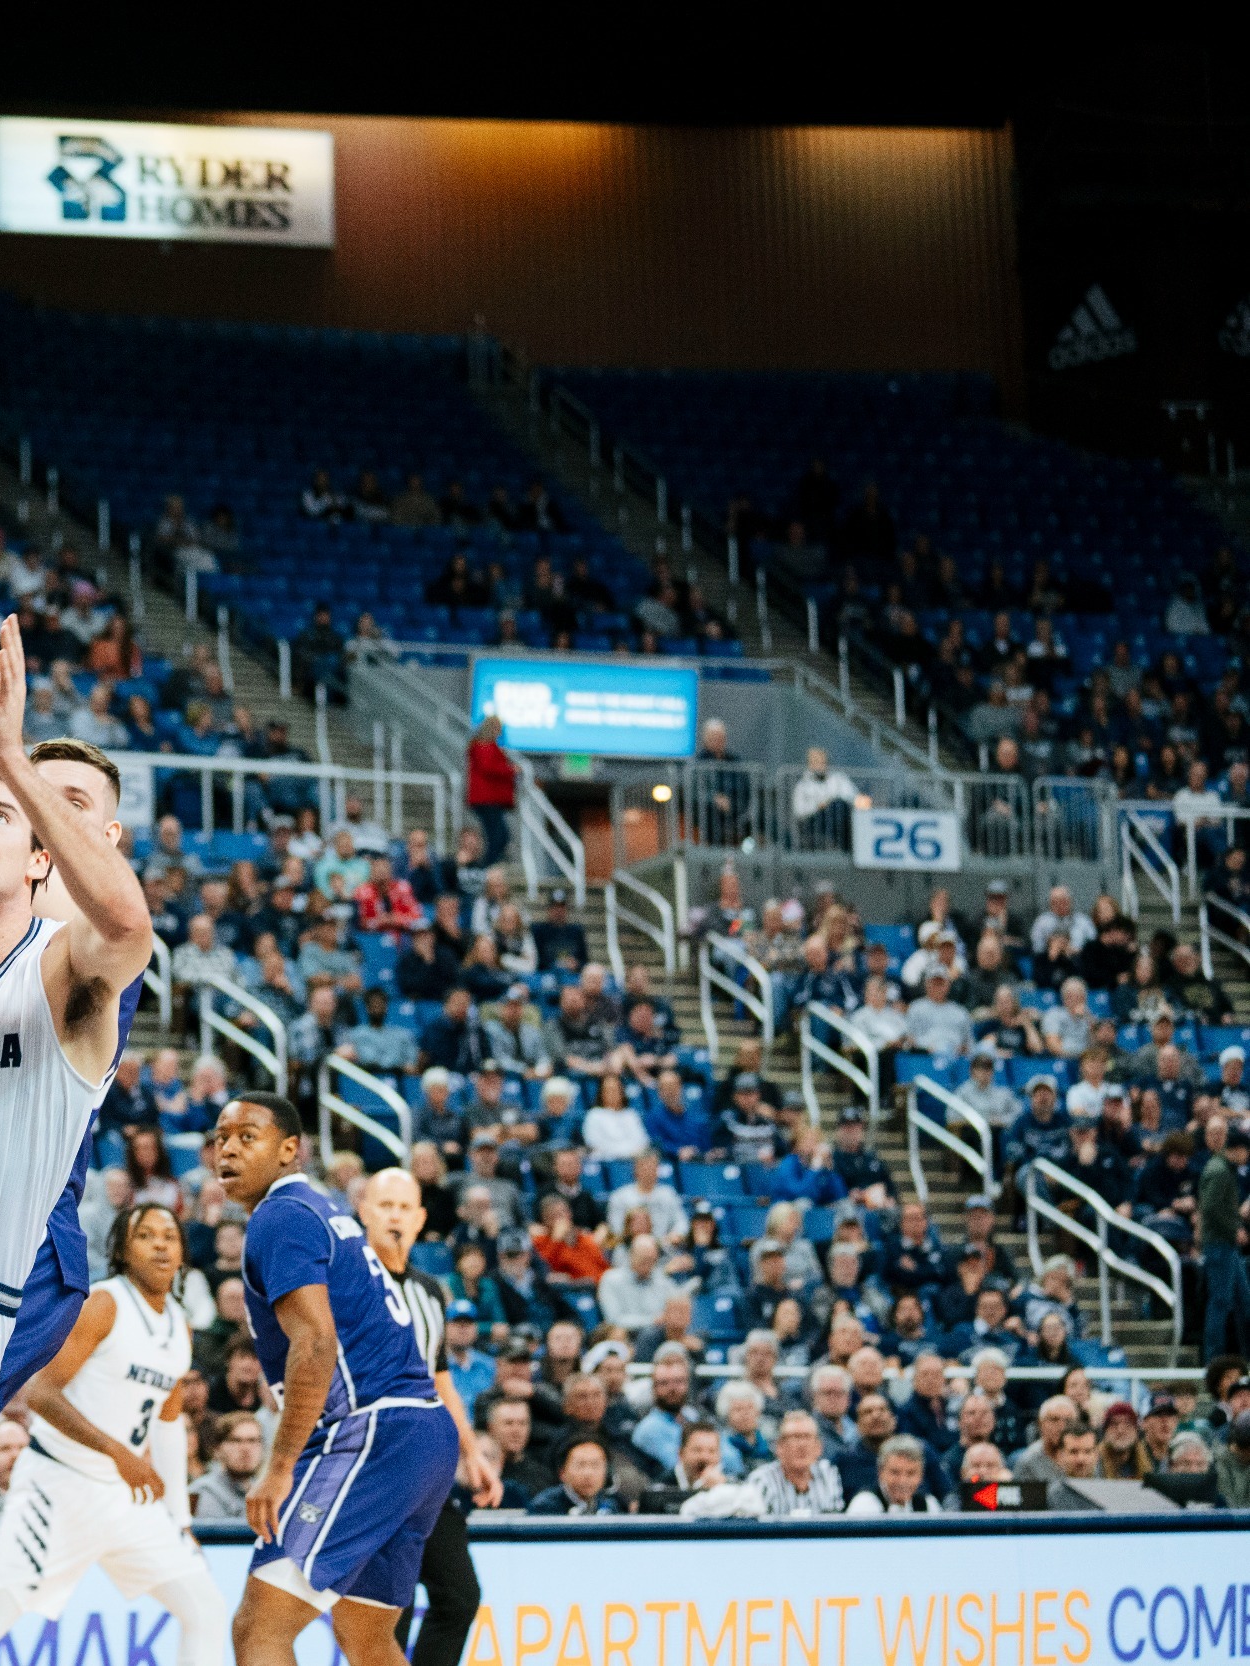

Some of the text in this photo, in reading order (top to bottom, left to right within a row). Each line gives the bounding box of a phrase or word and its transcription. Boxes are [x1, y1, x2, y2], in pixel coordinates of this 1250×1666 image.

[136, 154, 292, 193] RYDER
[137, 192, 292, 231] HOMES
[873, 817, 942, 861] 26
[125, 1363, 177, 1393] NEVAD
[129, 1398, 155, 1447] 3
[464, 1598, 860, 1666] APARTMENT
[875, 1590, 1091, 1666] WISHES
